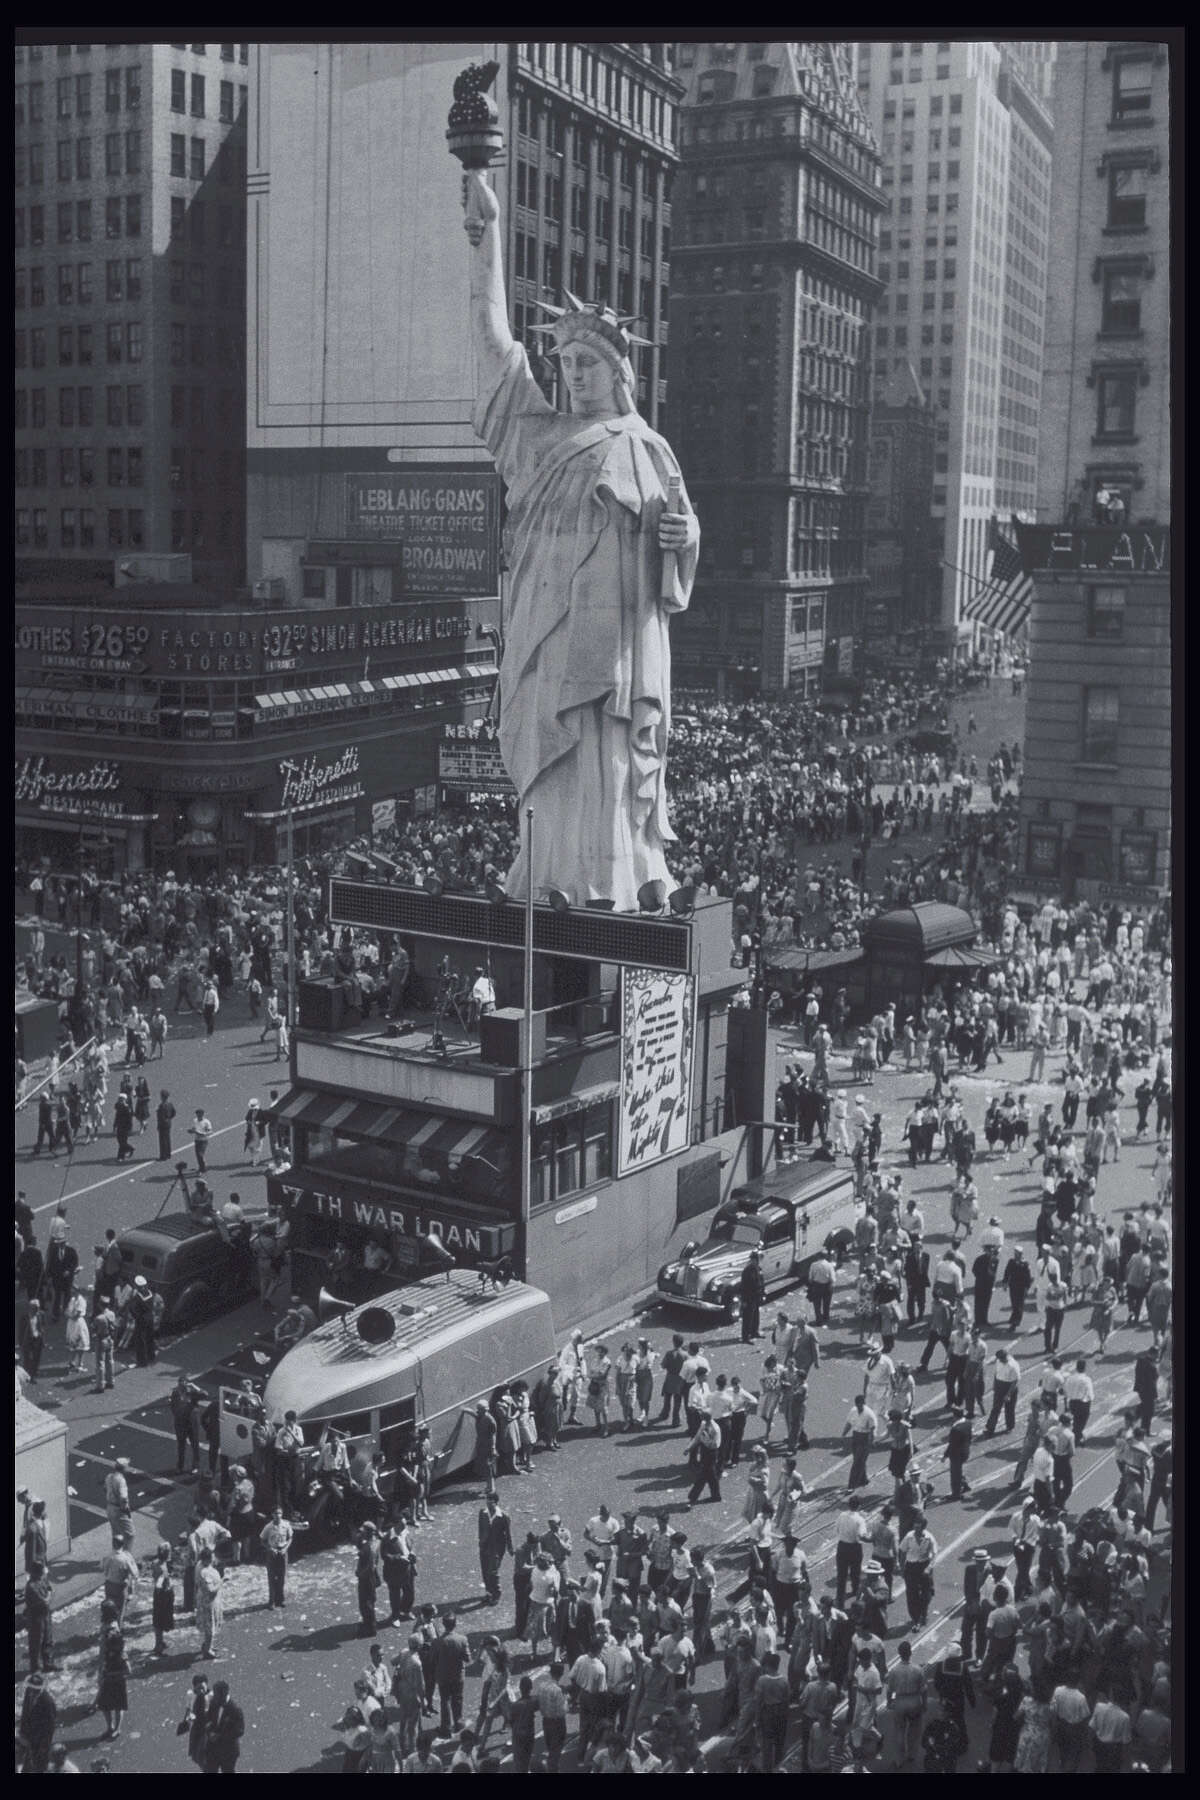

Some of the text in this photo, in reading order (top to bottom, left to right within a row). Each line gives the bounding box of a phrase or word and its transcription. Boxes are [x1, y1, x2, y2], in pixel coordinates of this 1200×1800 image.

[359, 514, 485, 532] THEATRE TICKET OFFICE
[402, 546, 486, 570] BROADWAY
[167, 653, 253, 671] STORES
[445, 724, 480, 739] NEW
[44, 795, 124, 815] RESTAURANT
[353, 1200, 405, 1234] WAR
[415, 1216, 481, 1252] LOAN
